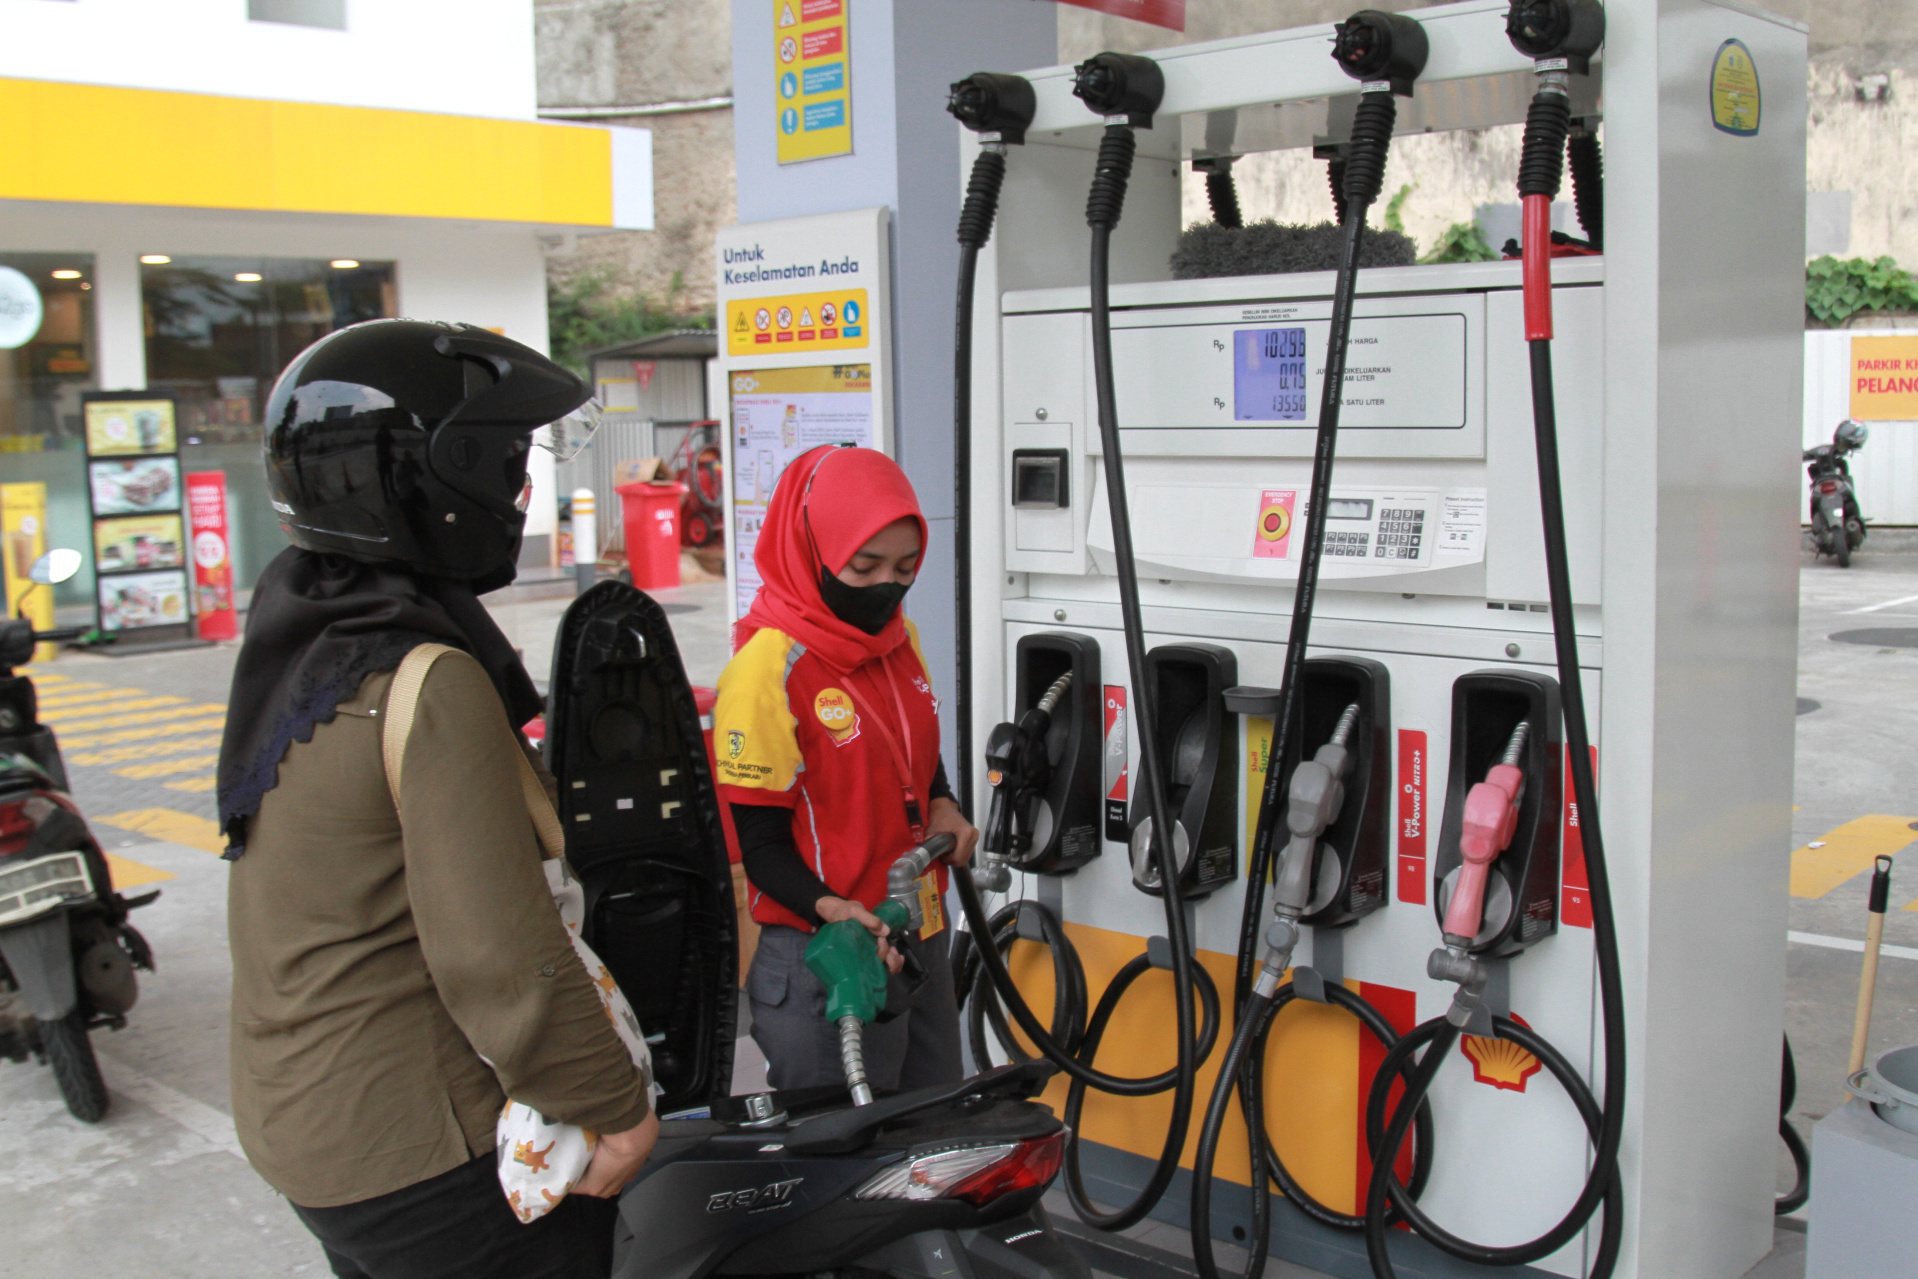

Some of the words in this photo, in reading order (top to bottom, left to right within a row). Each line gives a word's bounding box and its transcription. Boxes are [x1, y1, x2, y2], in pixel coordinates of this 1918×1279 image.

[723, 244, 764, 264] Untuk
[725, 266, 815, 285] Keselamatan
[820, 256, 859, 276] Anda
[1213, 340, 1225, 352] Rp
[1857, 359, 1901, 371] PARKIR
[733, 376, 760, 392] GO+
[1213, 397, 1225, 410] Rp
[1405, 510, 1411, 518] 9
[818, 696, 844, 707] Shell
[820, 707, 852, 721] GO+
[1115, 703, 1123, 756] V-Power
[1259, 737, 1269, 774] Super
[738, 763, 773, 775] PARTNER
[1411, 789, 1421, 838] V-Power
[1569, 803, 1578, 827] Shell
[1404, 818, 1412, 838] Shell
[1572, 896, 1581, 904] 95
[1003, 1229, 1044, 1244] HONDA
